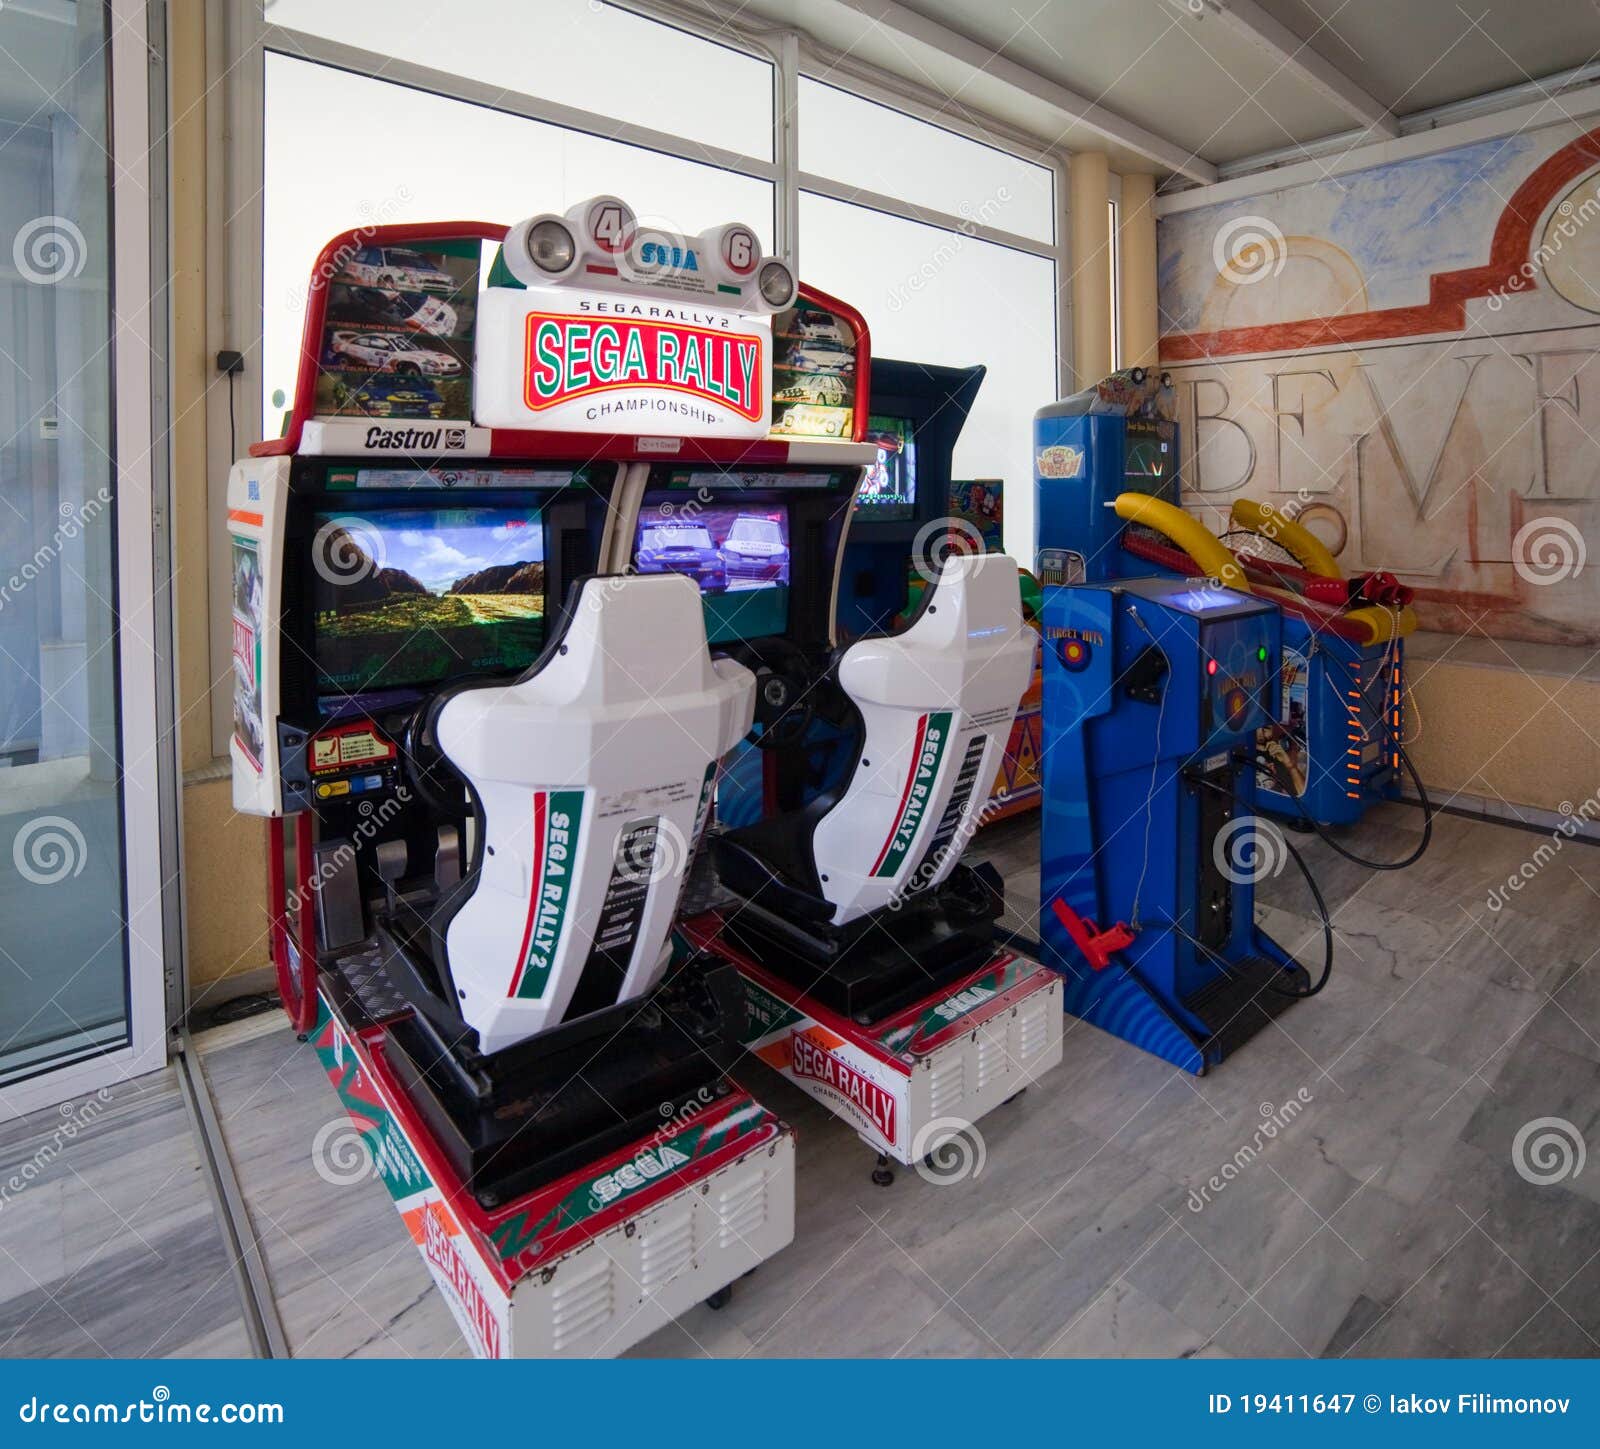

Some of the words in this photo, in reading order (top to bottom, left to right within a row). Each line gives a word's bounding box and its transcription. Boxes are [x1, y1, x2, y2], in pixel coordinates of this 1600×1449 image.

[595, 207, 623, 249] 4
[728, 231, 753, 270] 6
[533, 320, 648, 399] SEGA
[656, 329, 758, 411] RALLY
[364, 425, 443, 451] Castrol
[586, 399, 717, 425] CHAMPIONSHIP
[917, 727, 942, 780] SEGA
[900, 784, 929, 840] RALLY
[546, 811, 570, 877] SEGA
[892, 839, 906, 852] 2
[534, 883, 563, 954] RALLY
[529, 953, 548, 969] 2
[933, 986, 997, 1021] SEGA
[794, 1033, 836, 1084] SEGA
[838, 1065, 893, 1136] RALLY
[592, 1146, 691, 1203] SEGA
[426, 1206, 457, 1284] SEGA
[457, 1260, 498, 1359] RALLY
